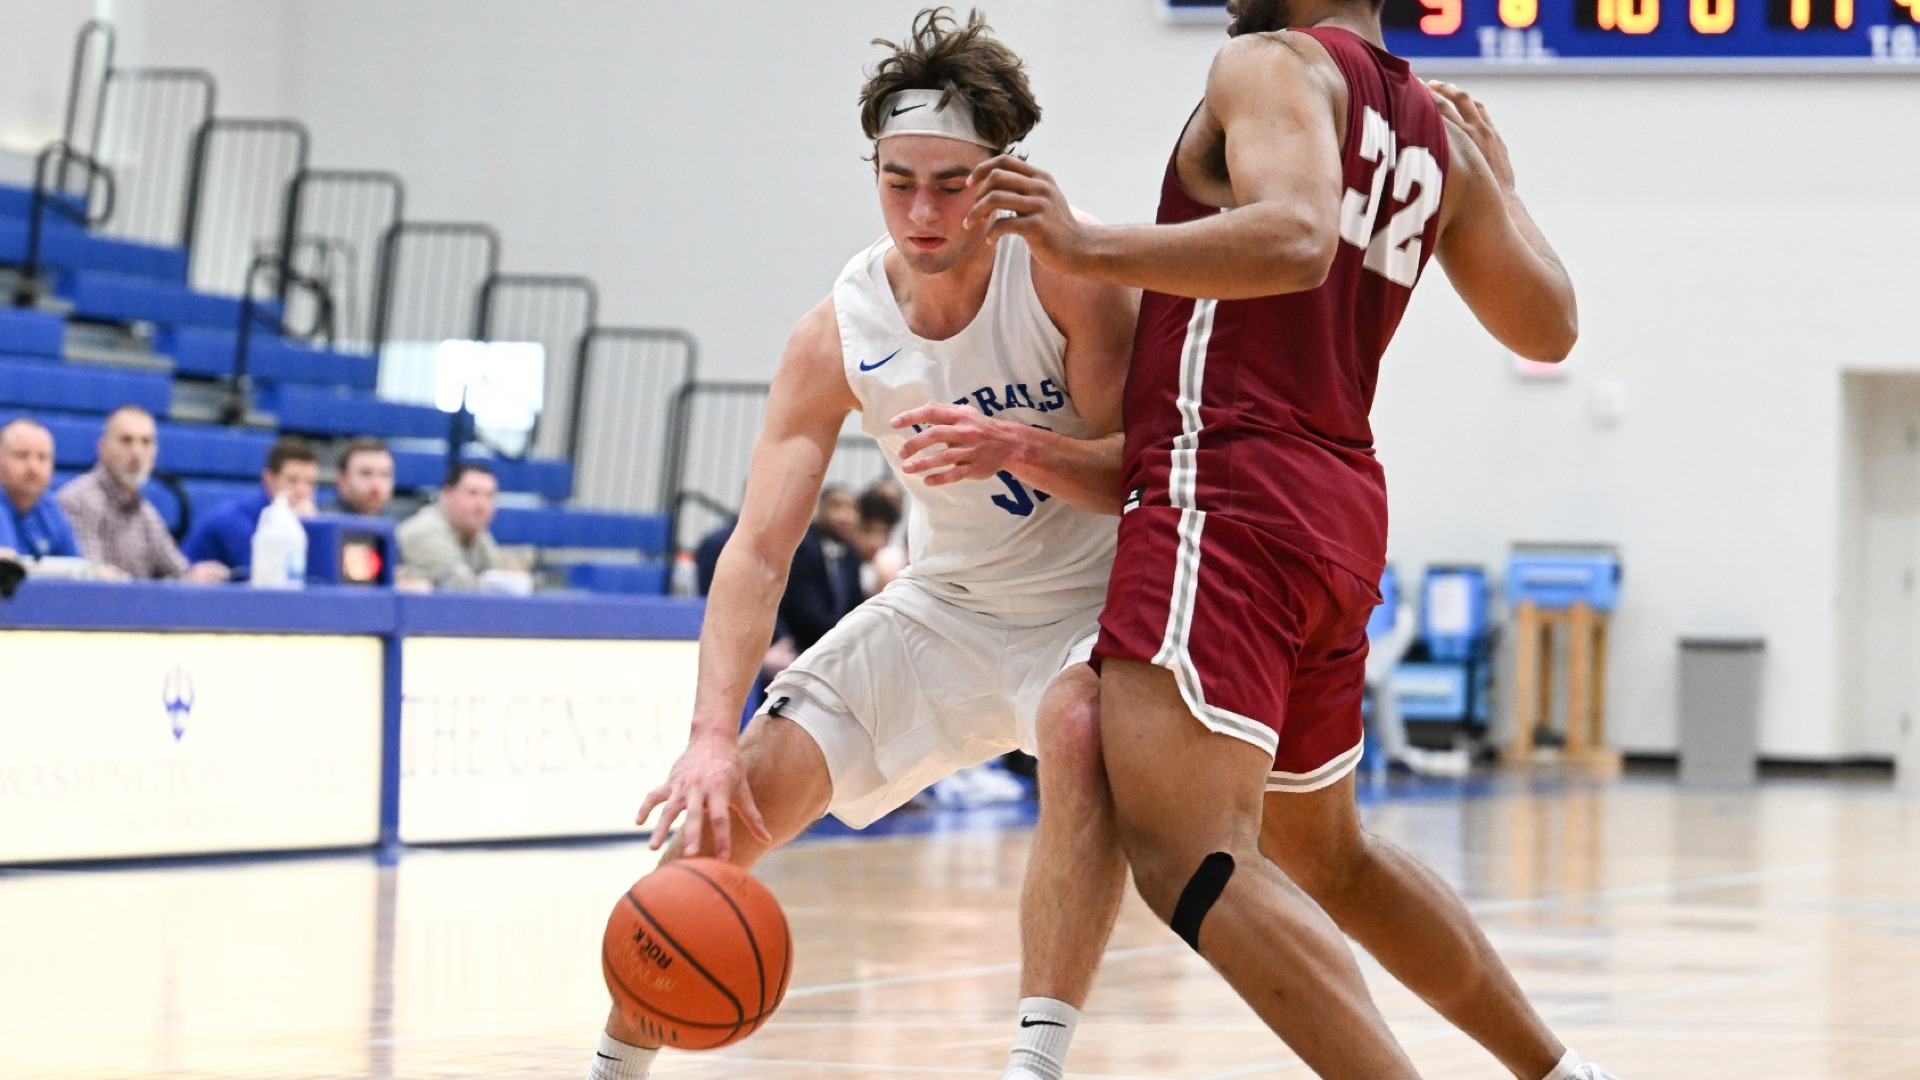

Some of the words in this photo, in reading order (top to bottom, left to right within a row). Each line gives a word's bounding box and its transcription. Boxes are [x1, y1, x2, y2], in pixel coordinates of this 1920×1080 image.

[1339, 105, 1443, 289] 32
[911, 378, 1065, 434] RALS
[634, 926, 673, 971] ROCK
